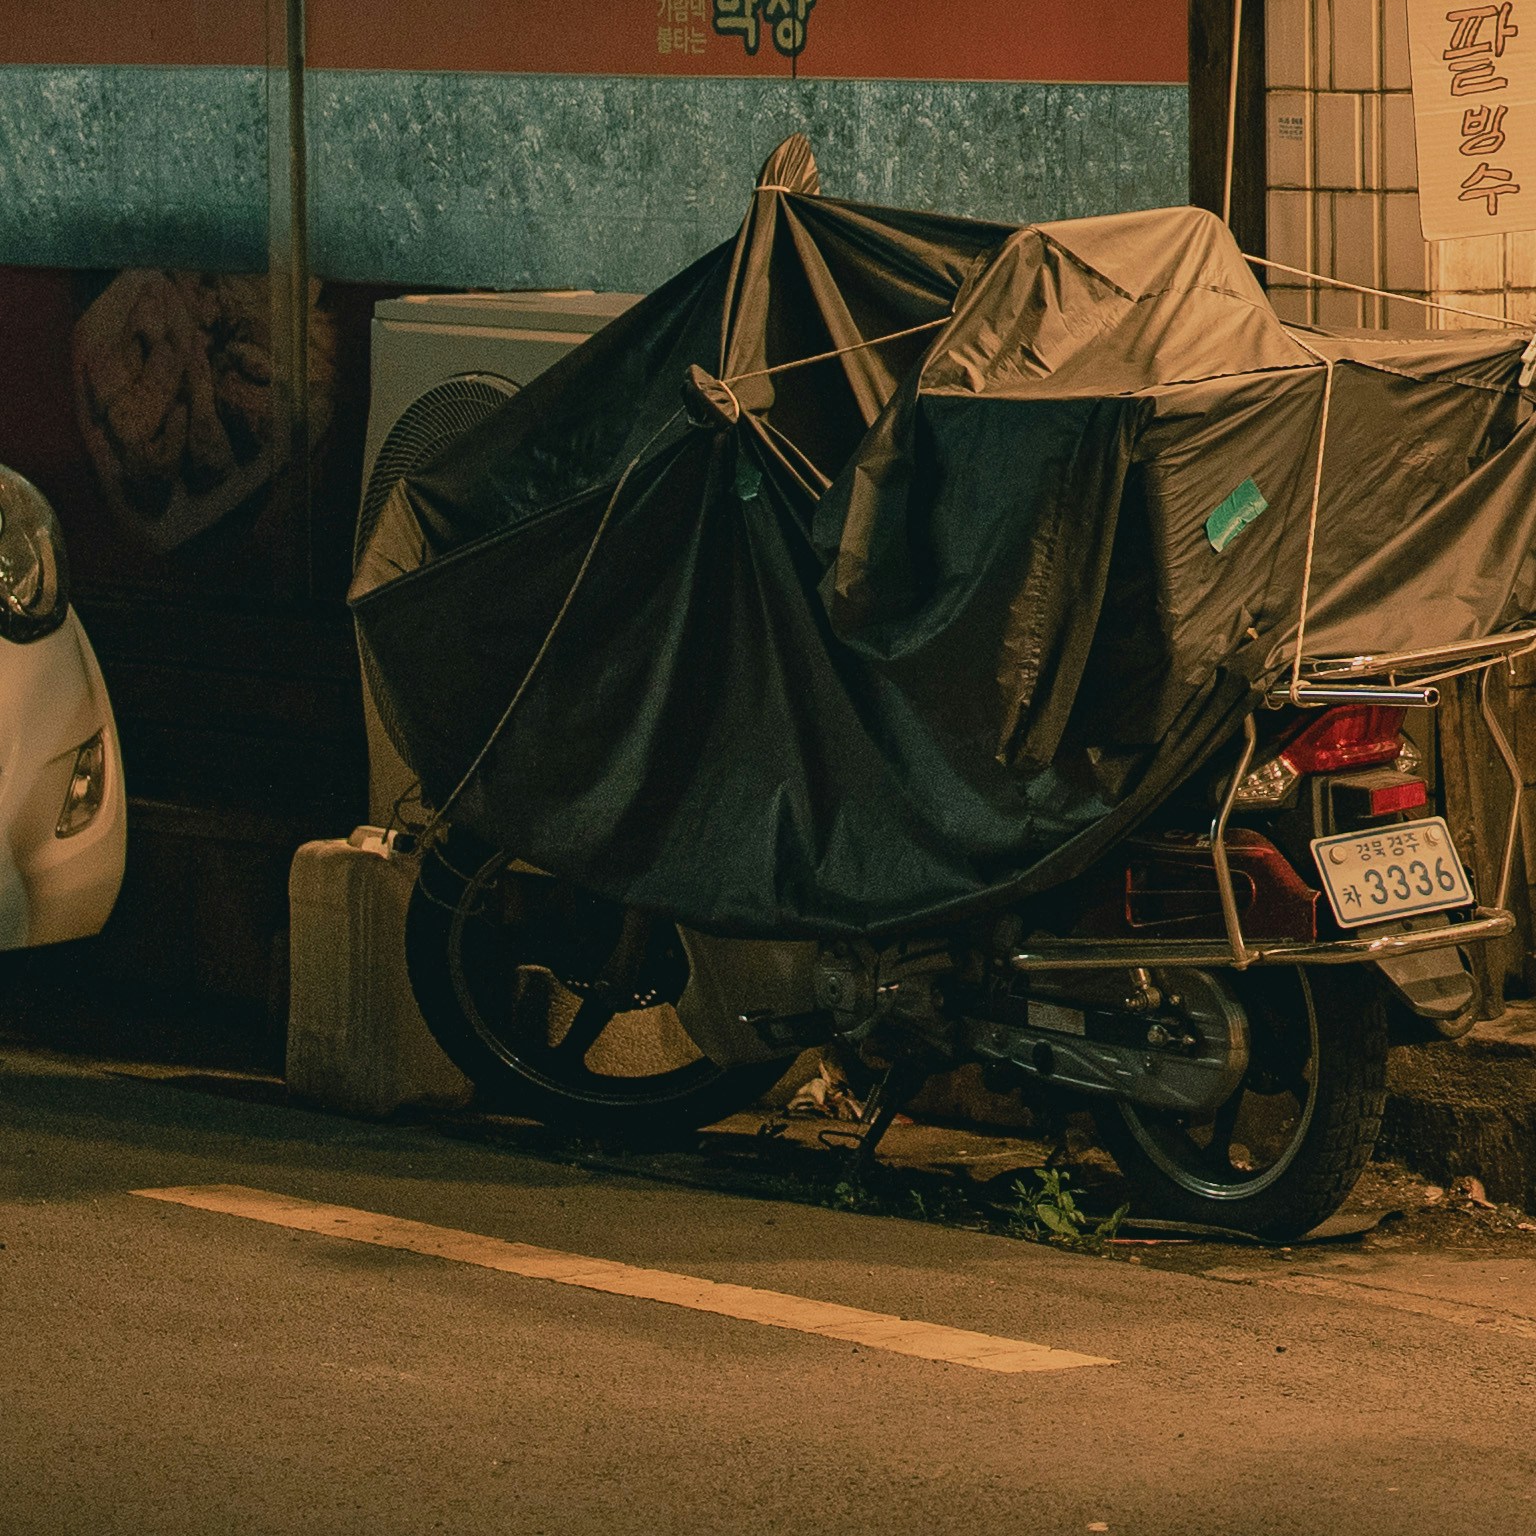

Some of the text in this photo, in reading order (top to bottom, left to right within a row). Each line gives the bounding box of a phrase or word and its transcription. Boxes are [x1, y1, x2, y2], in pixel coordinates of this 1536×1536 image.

[1442, 1, 1521, 216] 팥빙수
[1342, 856, 1456, 908] 차 3336
